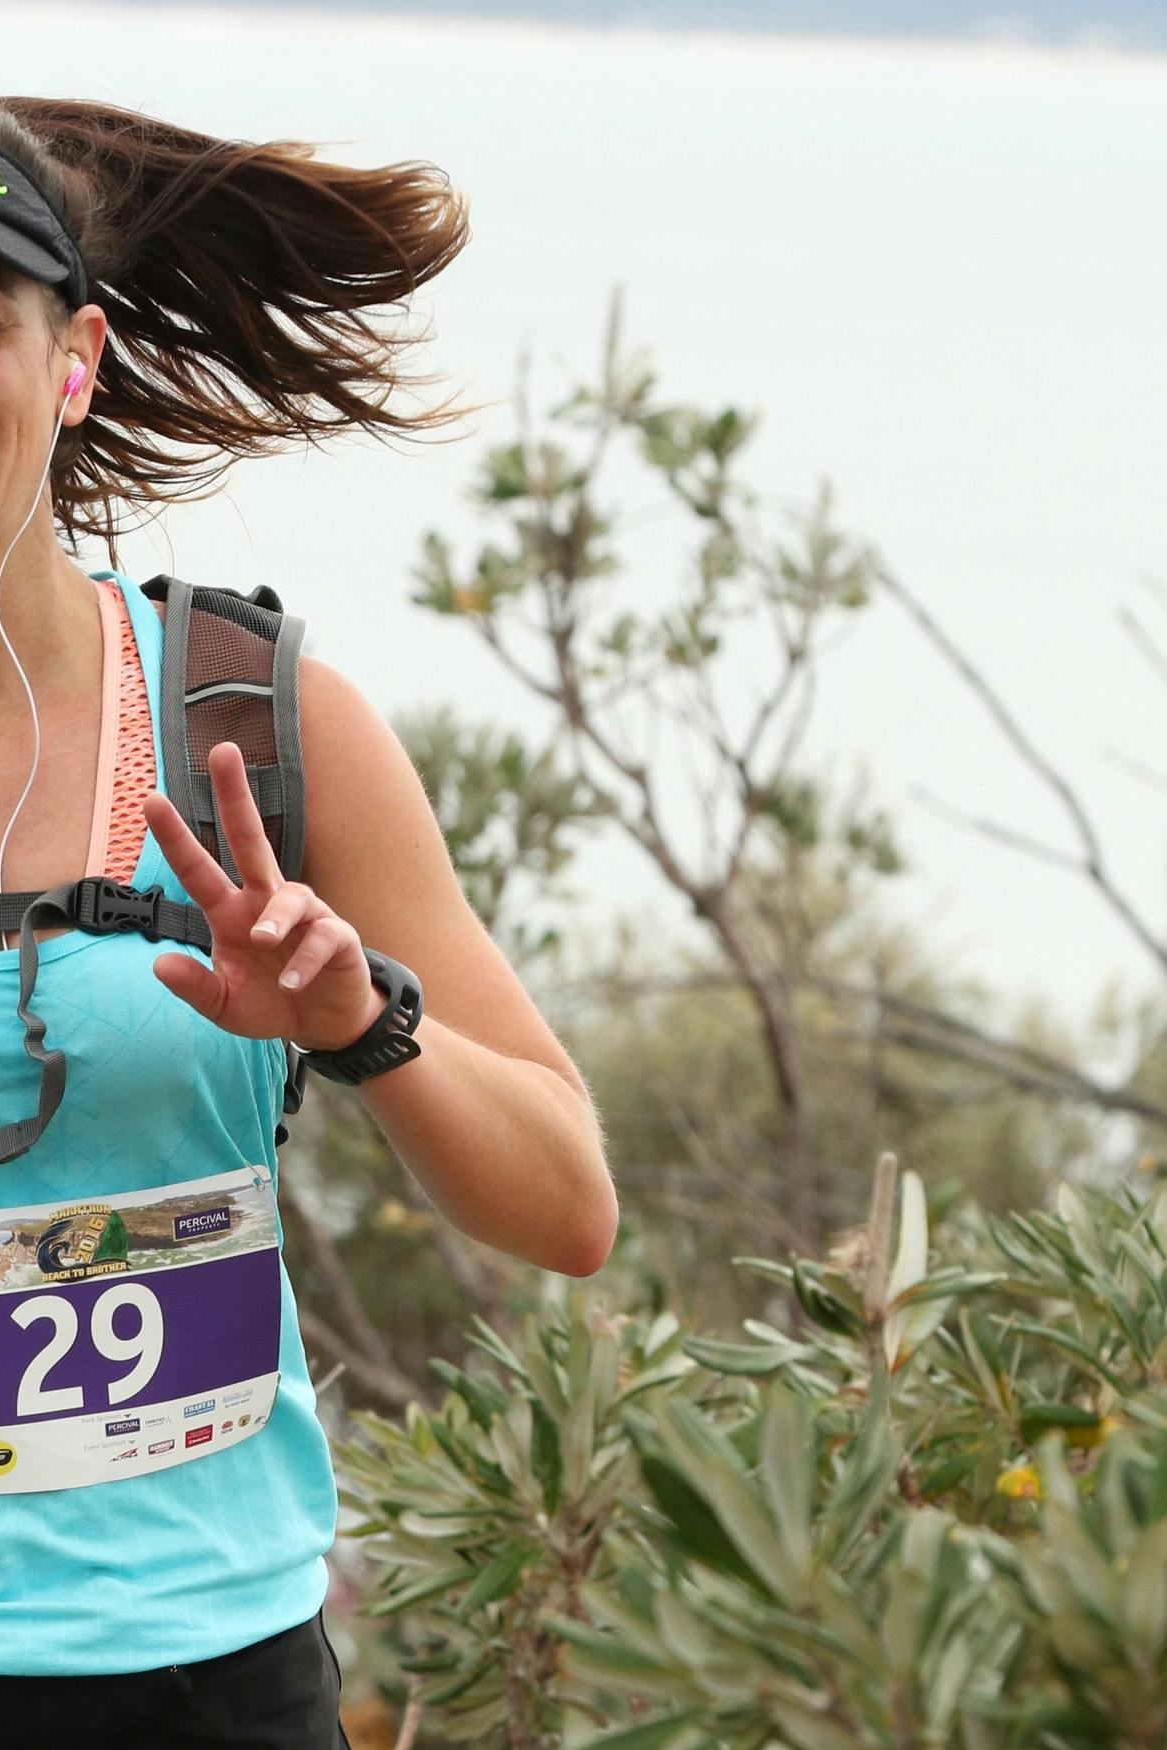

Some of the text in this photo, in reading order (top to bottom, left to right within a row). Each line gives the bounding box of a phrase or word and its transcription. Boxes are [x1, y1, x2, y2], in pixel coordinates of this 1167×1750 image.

[49, 1203, 112, 1223] MARATHON
[179, 1211, 229, 1230] PERCIVAL
[74, 1216, 106, 1265] 2016
[42, 1261, 128, 1283] BEACH TO BROTHER
[9, 1282, 165, 1418] 29
[108, 1420, 140, 1432] PERCIVAL
